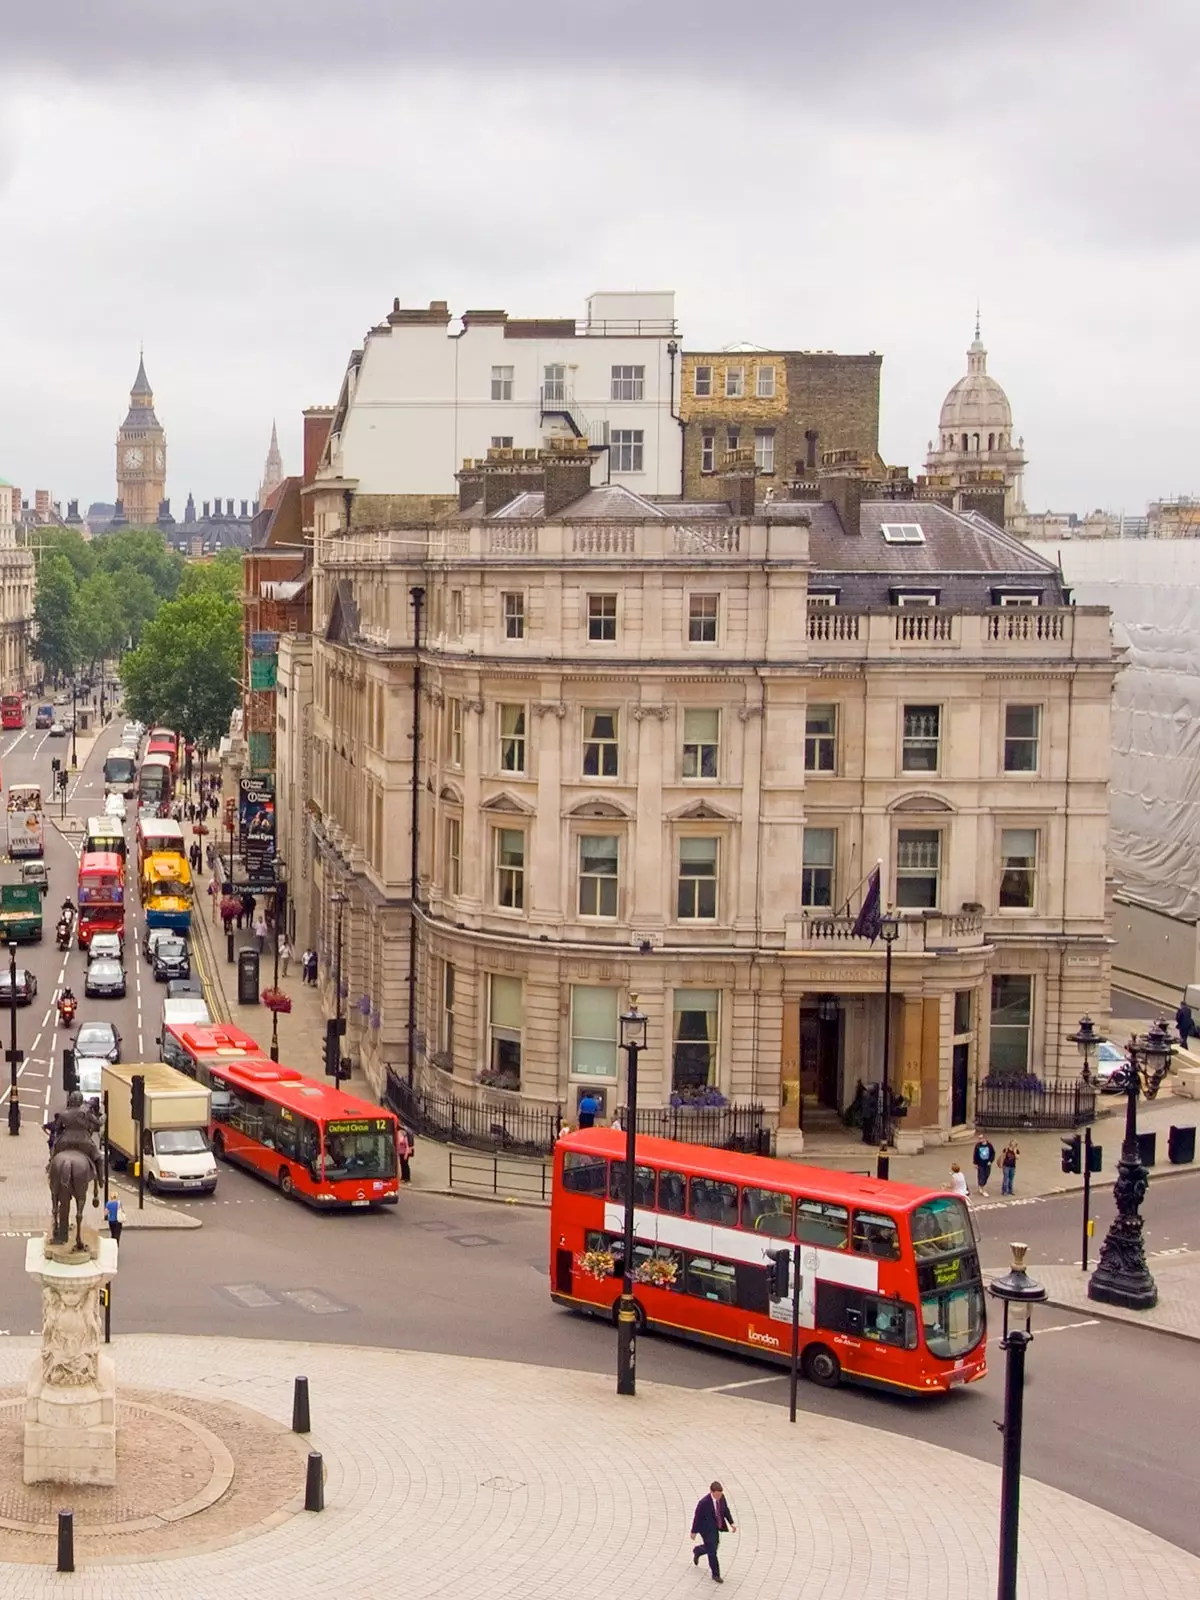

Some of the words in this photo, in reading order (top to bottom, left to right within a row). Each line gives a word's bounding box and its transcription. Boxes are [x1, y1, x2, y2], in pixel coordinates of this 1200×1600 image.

[328, 1125, 350, 1133] Oxford
[350, 1124, 369, 1132] Circus
[375, 1120, 386, 1130] 12
[748, 1328, 779, 1346] London
